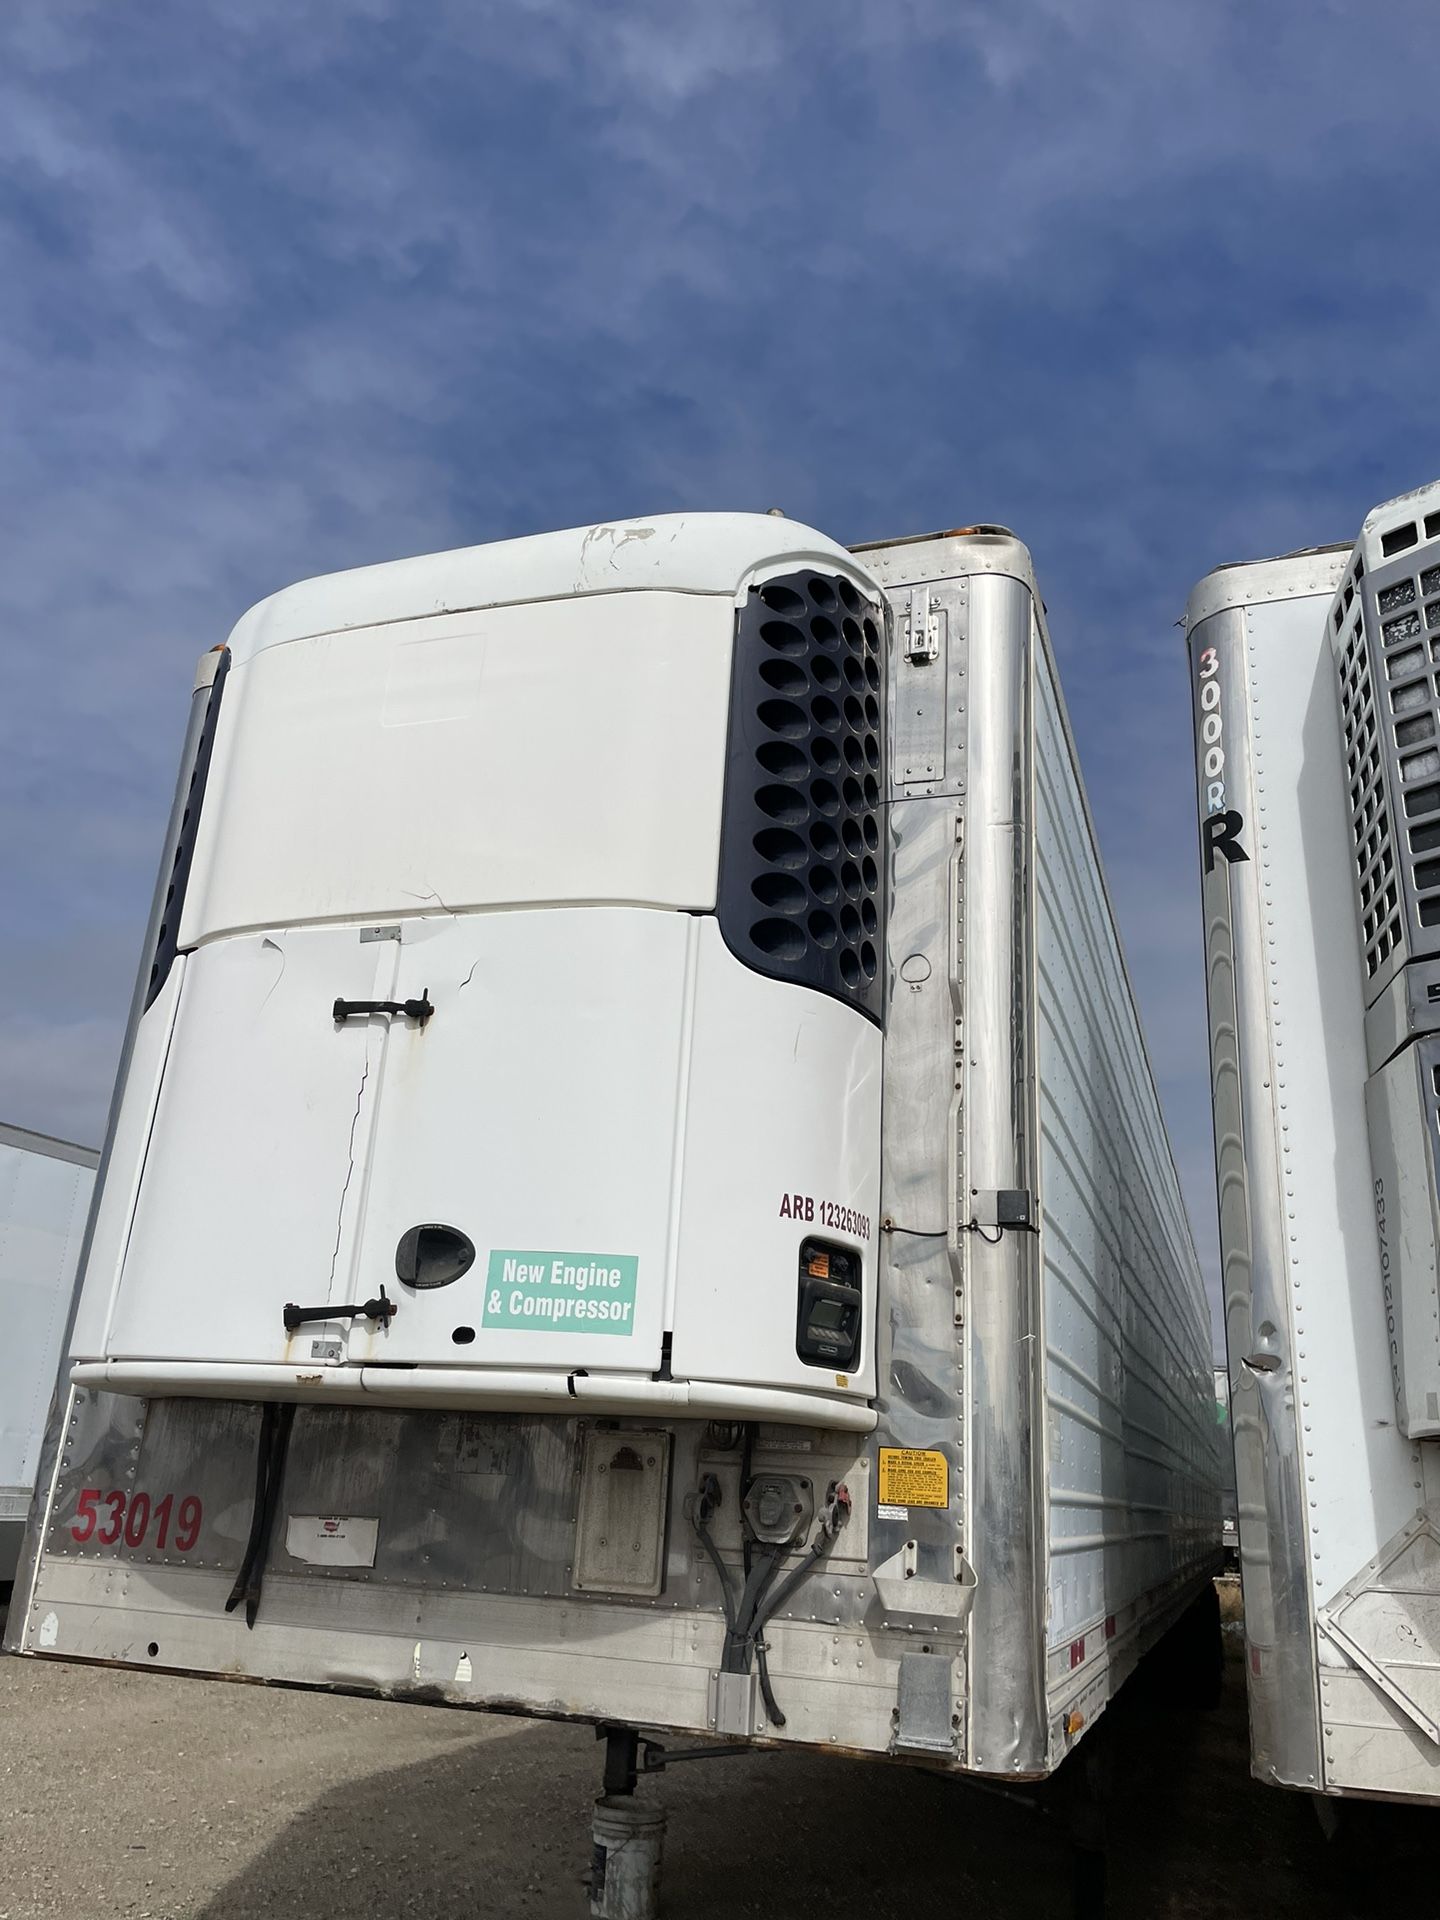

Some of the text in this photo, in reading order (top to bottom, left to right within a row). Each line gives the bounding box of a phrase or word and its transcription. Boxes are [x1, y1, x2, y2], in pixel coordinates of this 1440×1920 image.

[779, 1193, 870, 1240] ARB 123263093
[502, 1259, 621, 1291] New Engine
[487, 1289, 631, 1322] & Compressor
[71, 1488, 203, 1552] 53019
